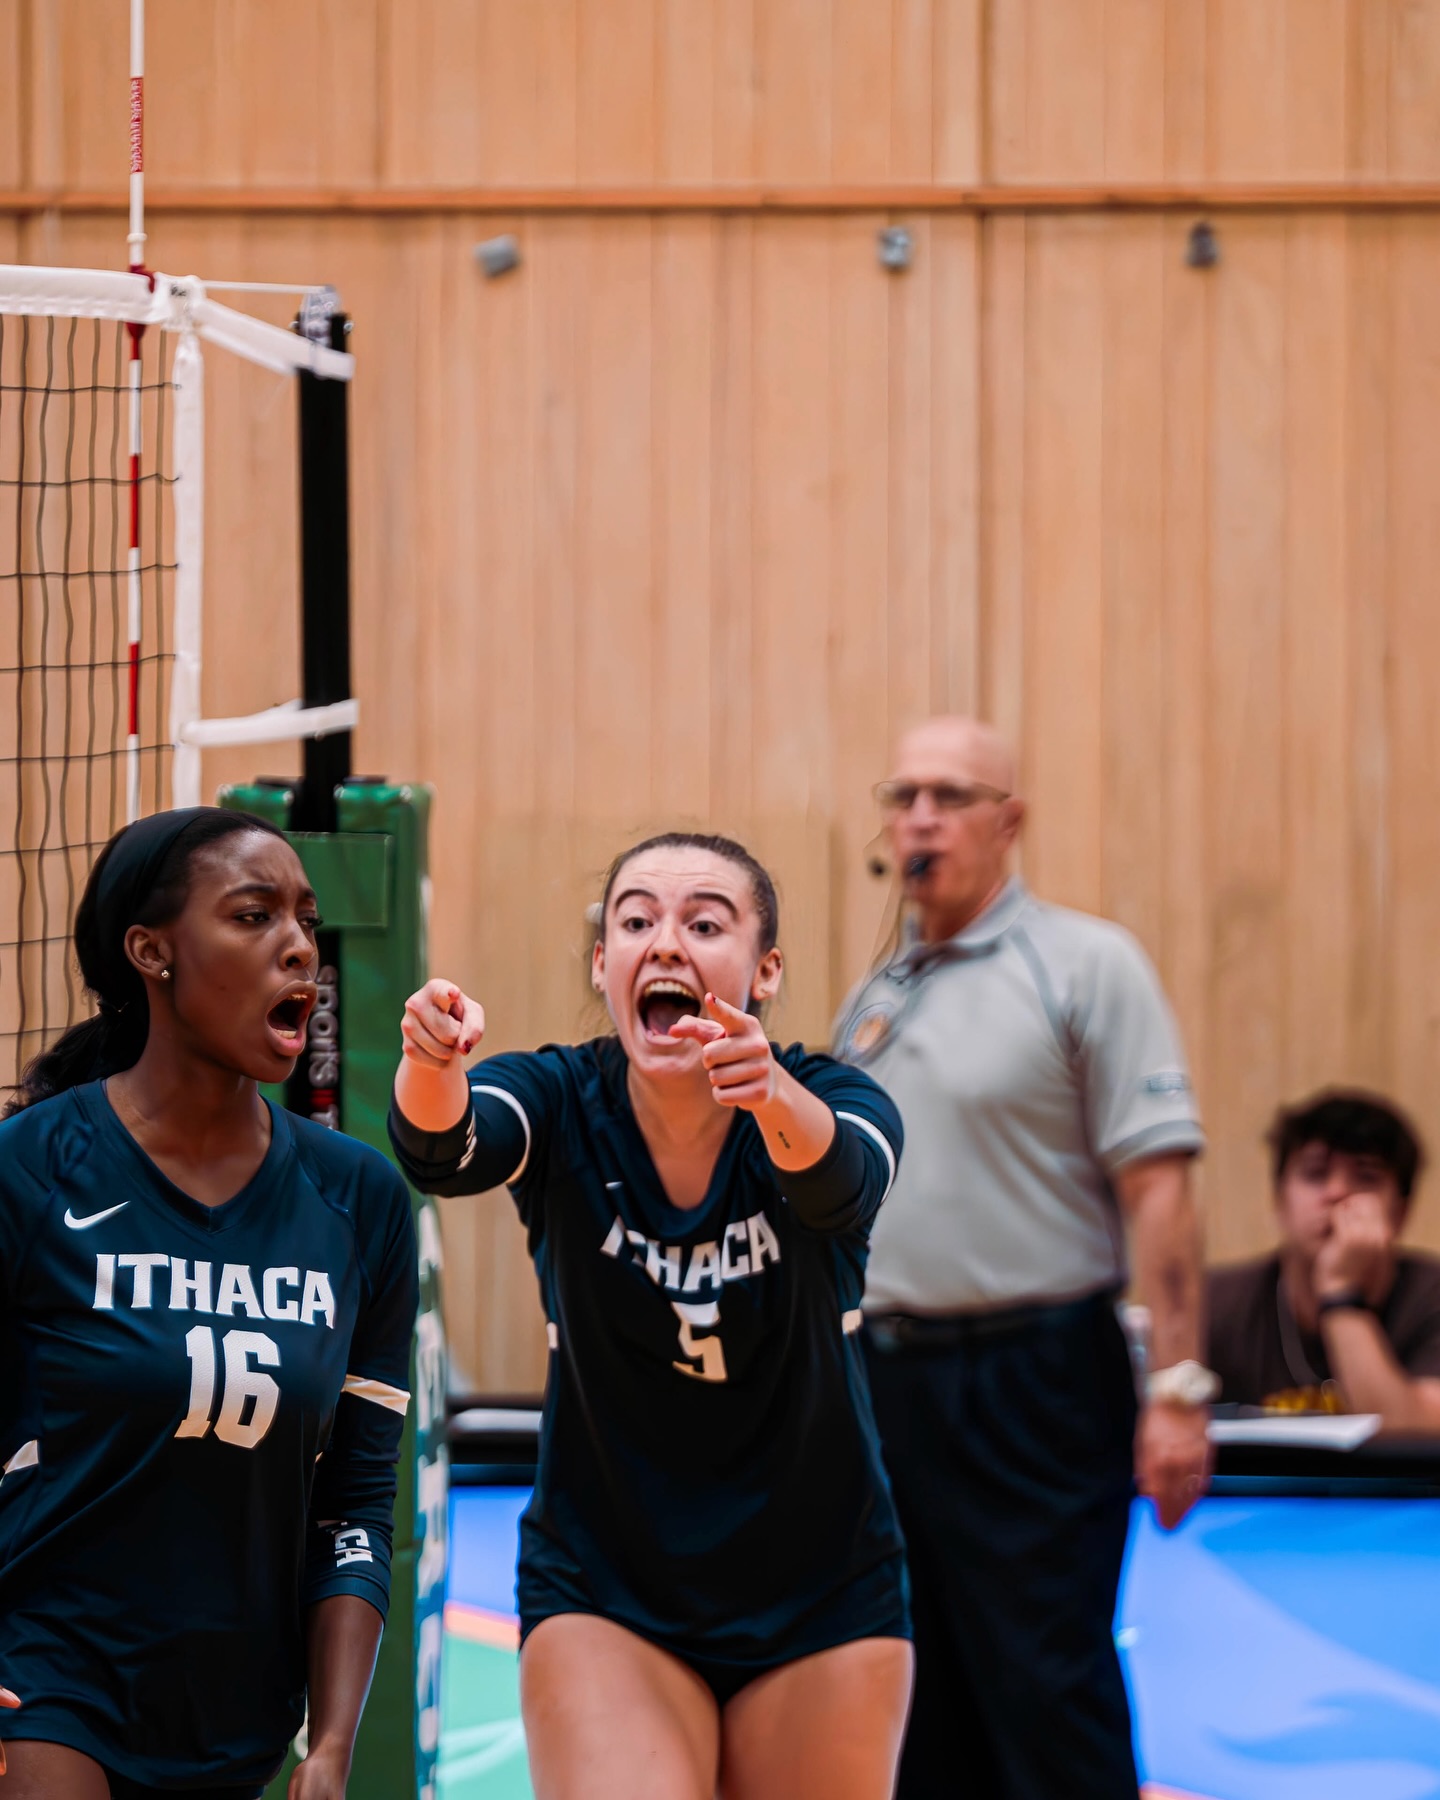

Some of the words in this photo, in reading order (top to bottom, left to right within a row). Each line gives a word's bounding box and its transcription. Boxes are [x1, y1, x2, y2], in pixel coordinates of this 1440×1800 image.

[92, 1253, 336, 1330] ITHACA
[671, 1300, 728, 1383] 5
[174, 1325, 282, 1450] 16
